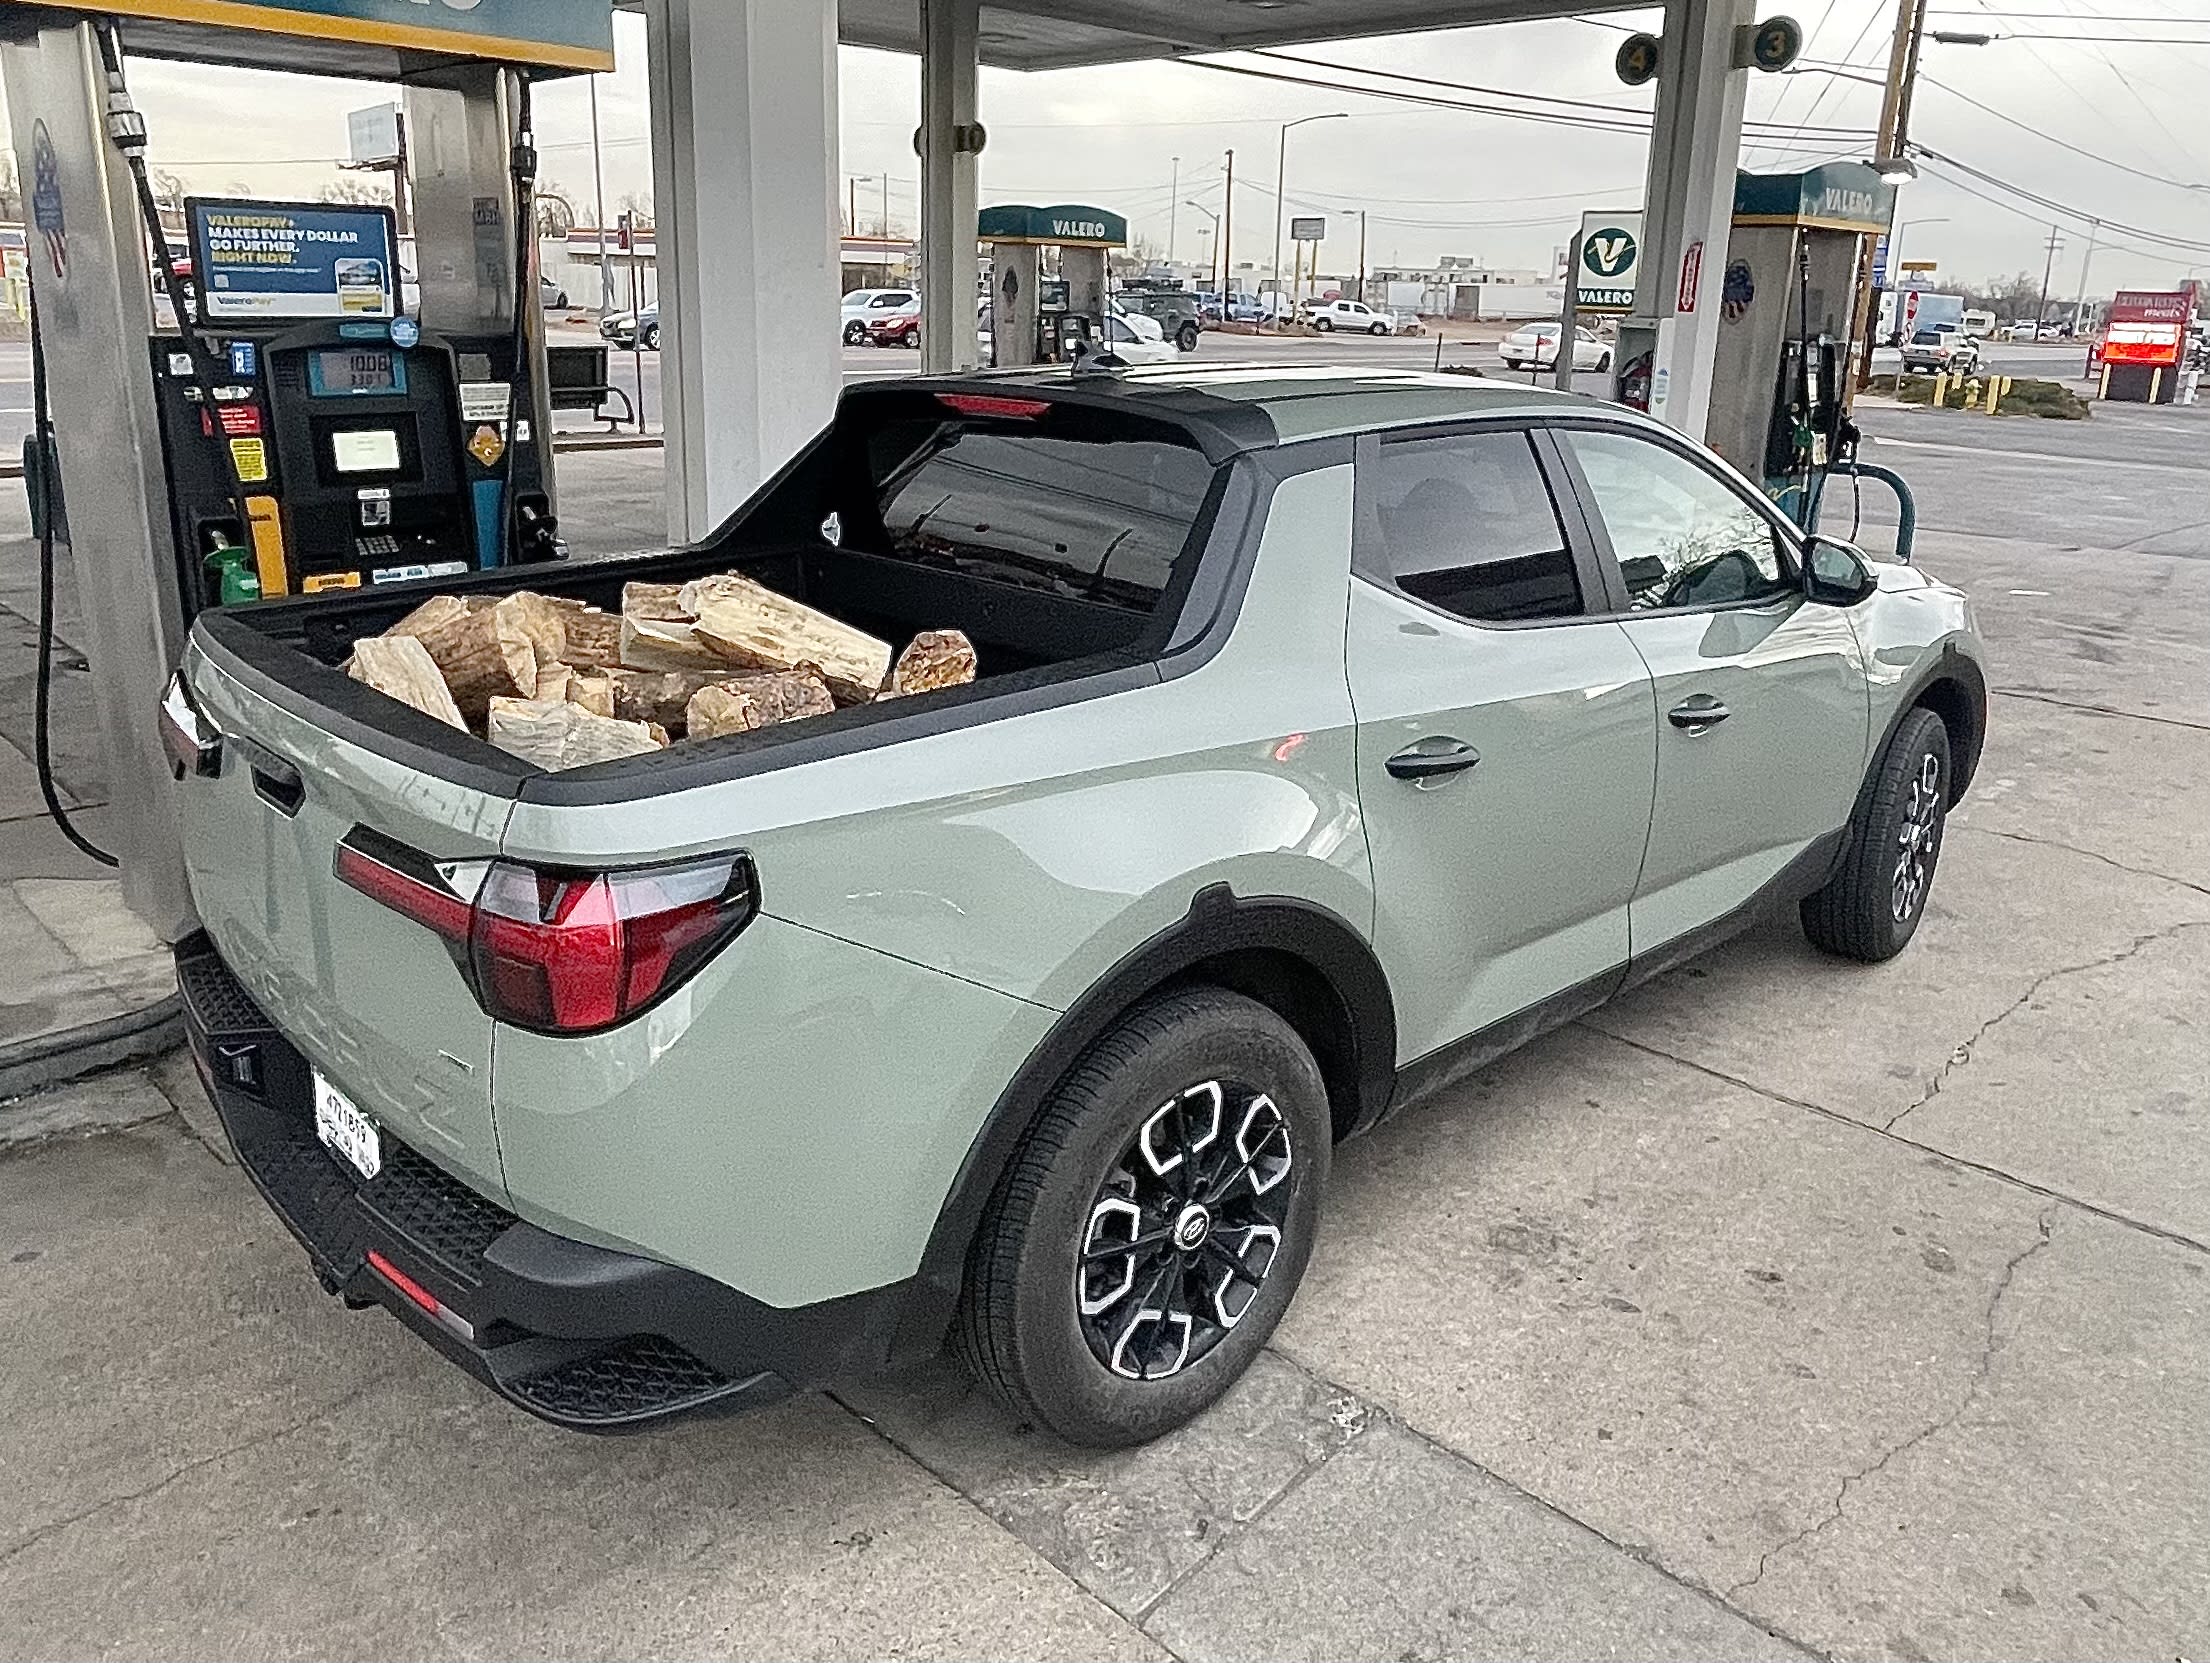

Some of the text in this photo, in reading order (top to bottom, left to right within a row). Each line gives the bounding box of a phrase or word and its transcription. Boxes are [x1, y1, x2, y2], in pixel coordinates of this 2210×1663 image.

[1766, 31, 1786, 58] 3
[1628, 46, 1647, 71] 4
[1826, 187, 1873, 215] VALERO
[208, 226, 359, 243] MAKES EVERY DOLLAR
[1052, 219, 1106, 238] VALERO
[209, 239, 232, 251] GO
[211, 251, 254, 263] RIGHT
[1578, 289, 1633, 304] VALERO
